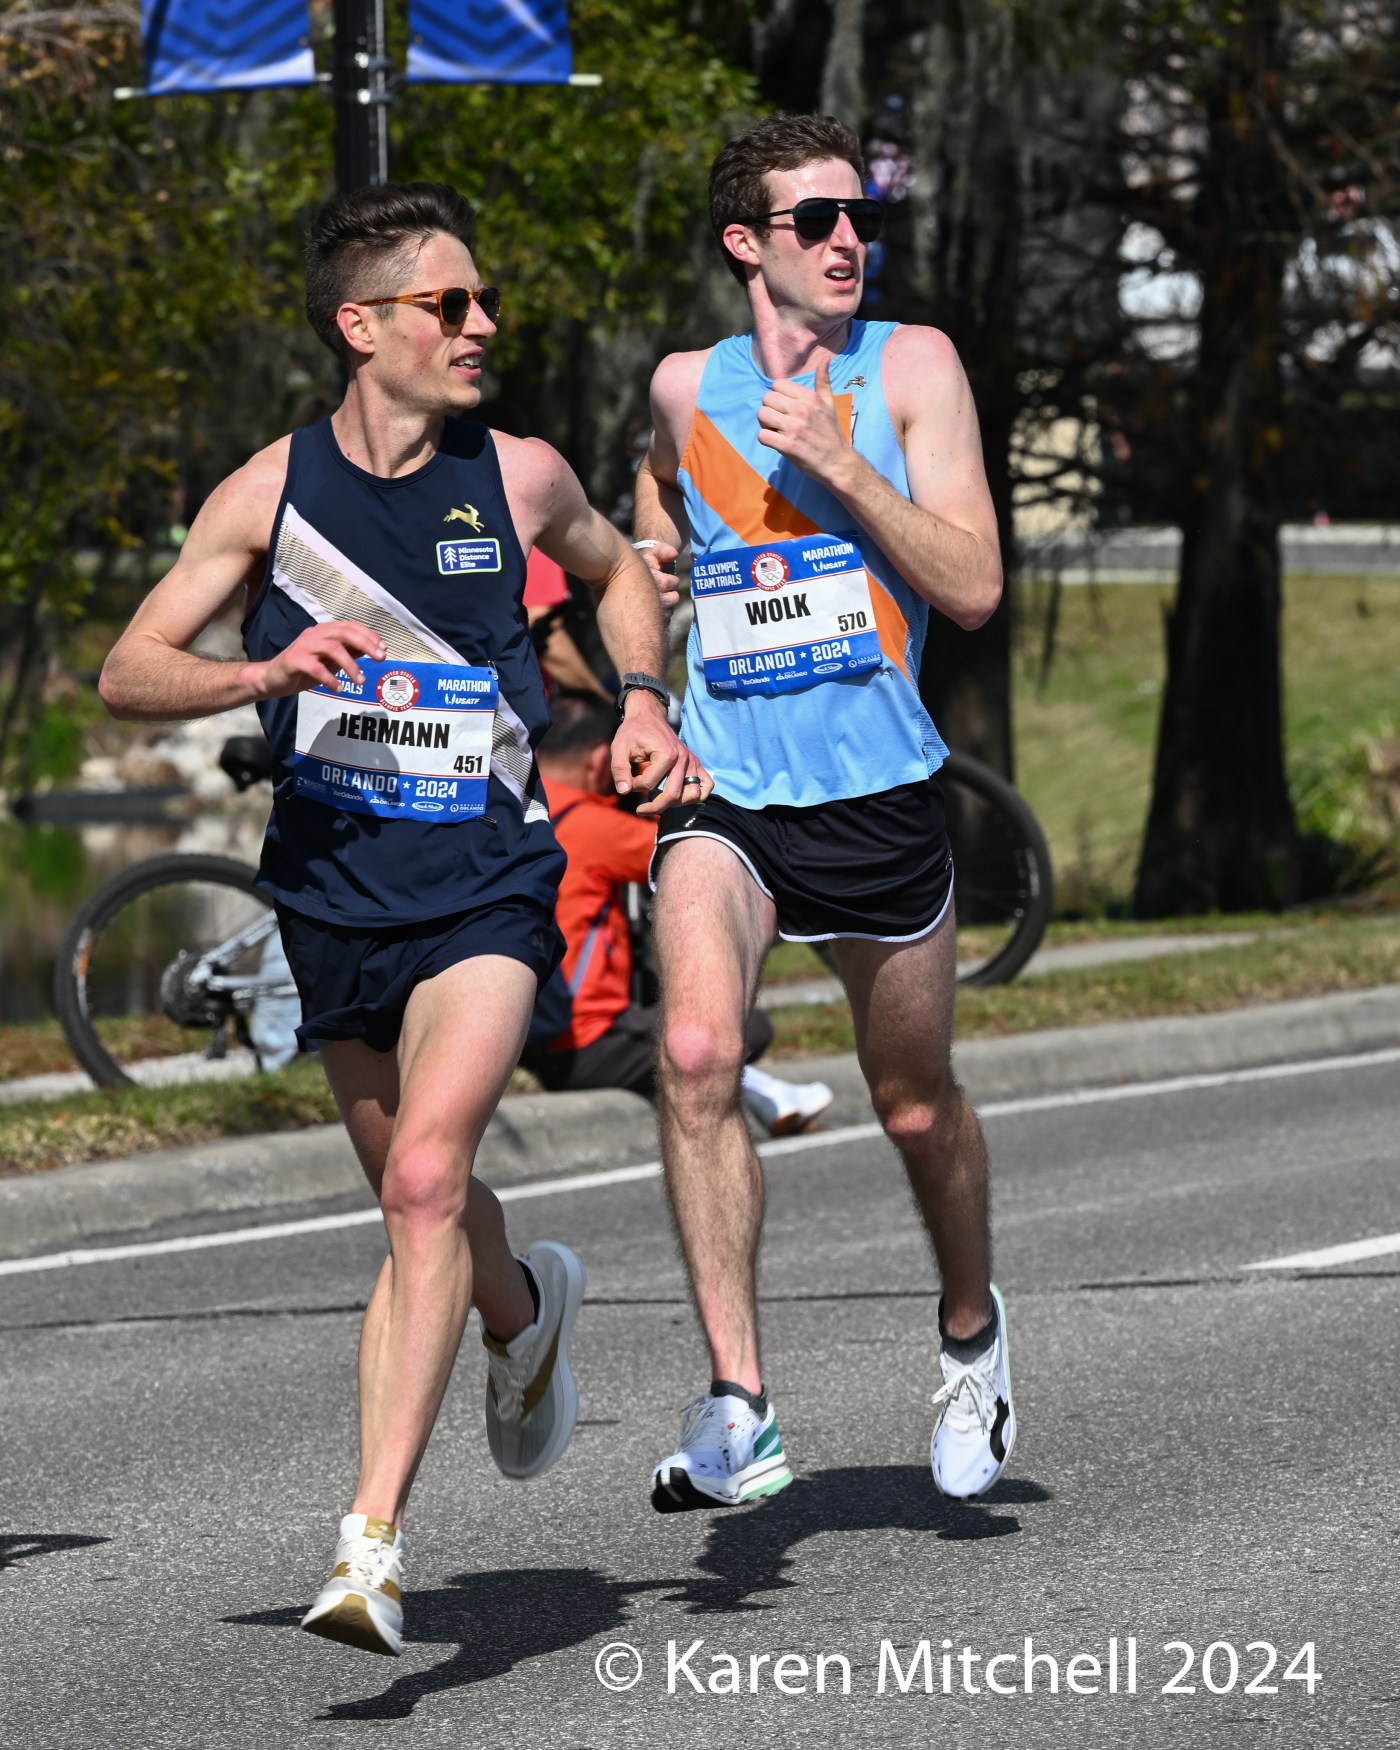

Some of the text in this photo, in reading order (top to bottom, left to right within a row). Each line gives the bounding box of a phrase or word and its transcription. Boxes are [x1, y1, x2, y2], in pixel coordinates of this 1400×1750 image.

[802, 543, 854, 562] MARATHON
[693, 561, 739, 578] U.S. OLYMPIC
[823, 560, 848, 571] USATF
[695, 574, 742, 590] TEAM TRIALS
[745, 593, 812, 626] WOLK
[837, 611, 867, 632] 570
[729, 640, 851, 676] ORLANDO 2024
[381, 670, 416, 684] UNITED STATES
[437, 679, 491, 693] MARATHON
[380, 699, 413, 711] OLYMPIC TEAM
[455, 697, 480, 705] USATF
[336, 712, 450, 749] JERMANN
[453, 755, 483, 773] 451
[321, 764, 398, 793] ORLANDO
[415, 780, 458, 798] 2024
